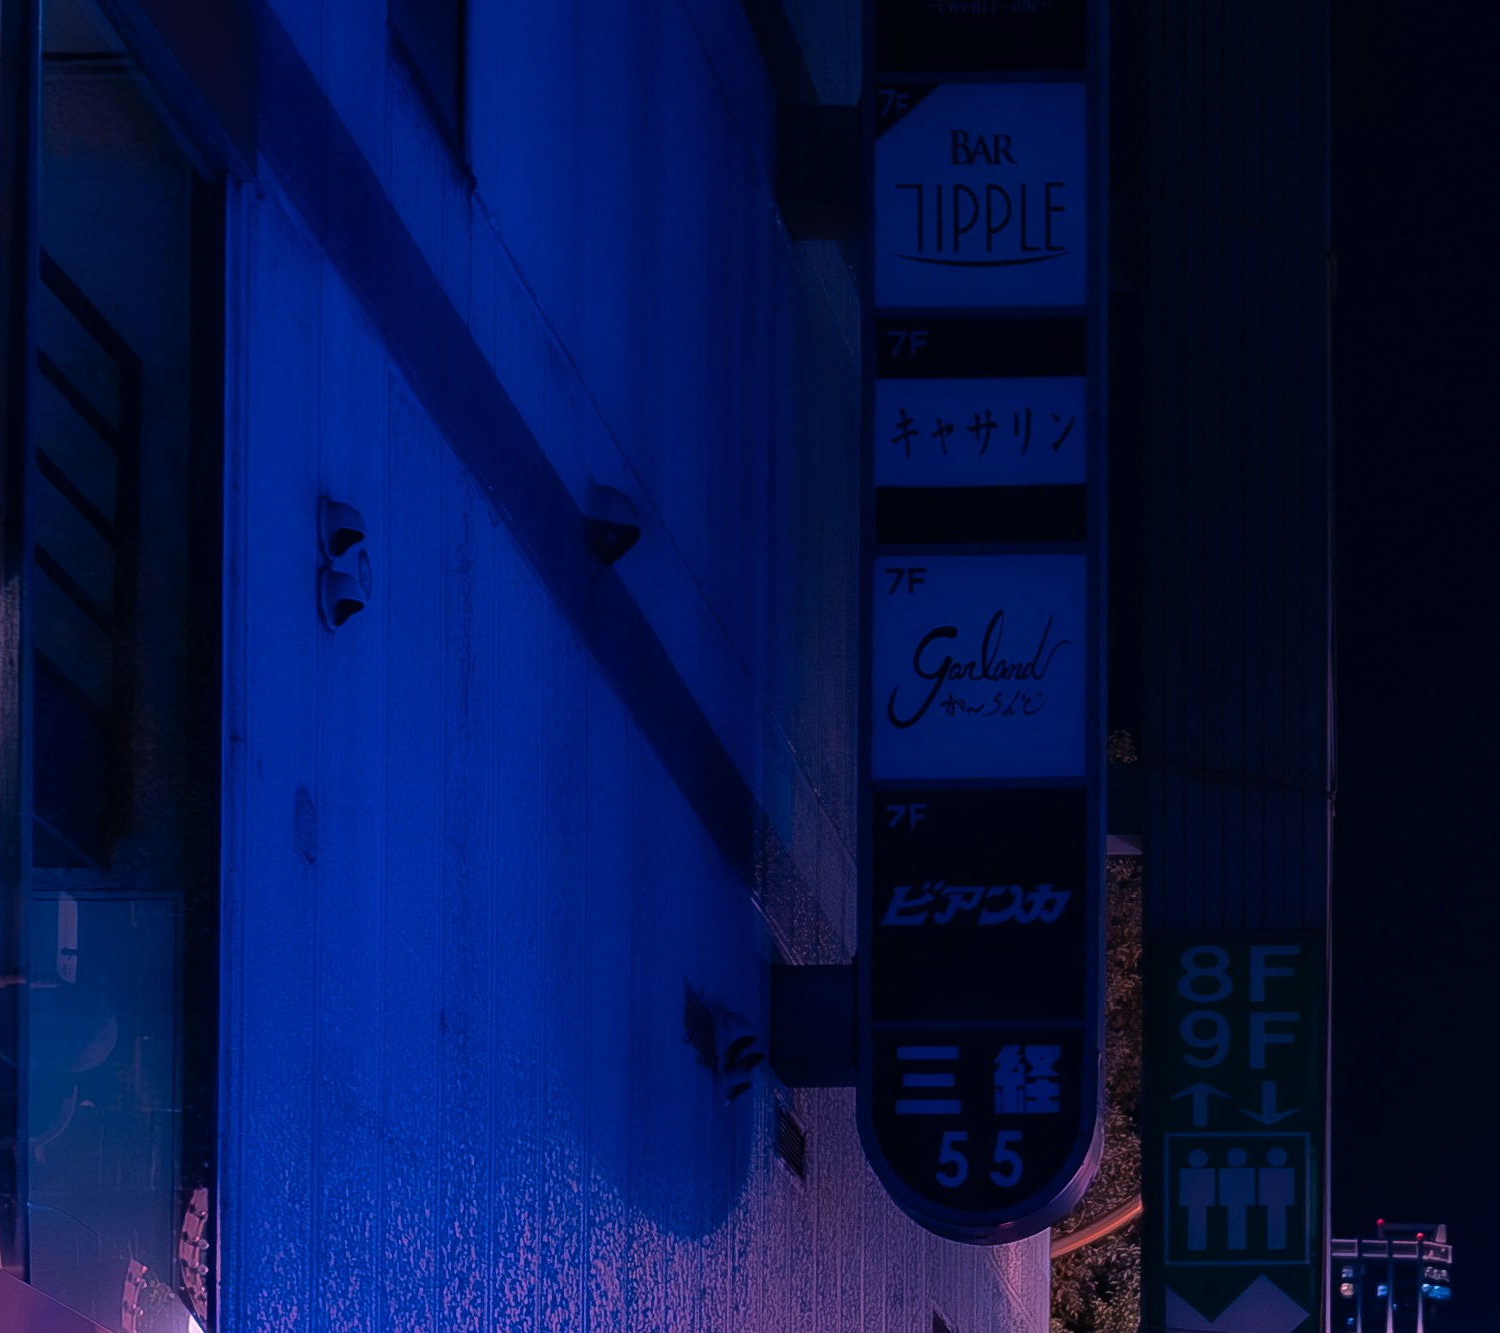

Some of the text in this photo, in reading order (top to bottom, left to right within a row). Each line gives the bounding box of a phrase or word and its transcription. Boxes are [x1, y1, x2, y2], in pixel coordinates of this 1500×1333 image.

[879, 89, 909, 117] 7F
[950, 128, 1019, 166] BAR
[894, 181, 1067, 254] TIPPLE
[887, 331, 929, 358] 7F
[890, 407, 1077, 459] キャサリン
[885, 567, 927, 595] 7F
[887, 608, 1072, 730] Garland
[886, 803, 928, 829] 7F
[880, 880, 1073, 927] ビアンカ
[1177, 945, 1301, 1003] 8F
[1180, 1010, 1301, 1070] 9F
[895, 1044, 1062, 1115] 三経
[934, 1131, 1024, 1188] 55
